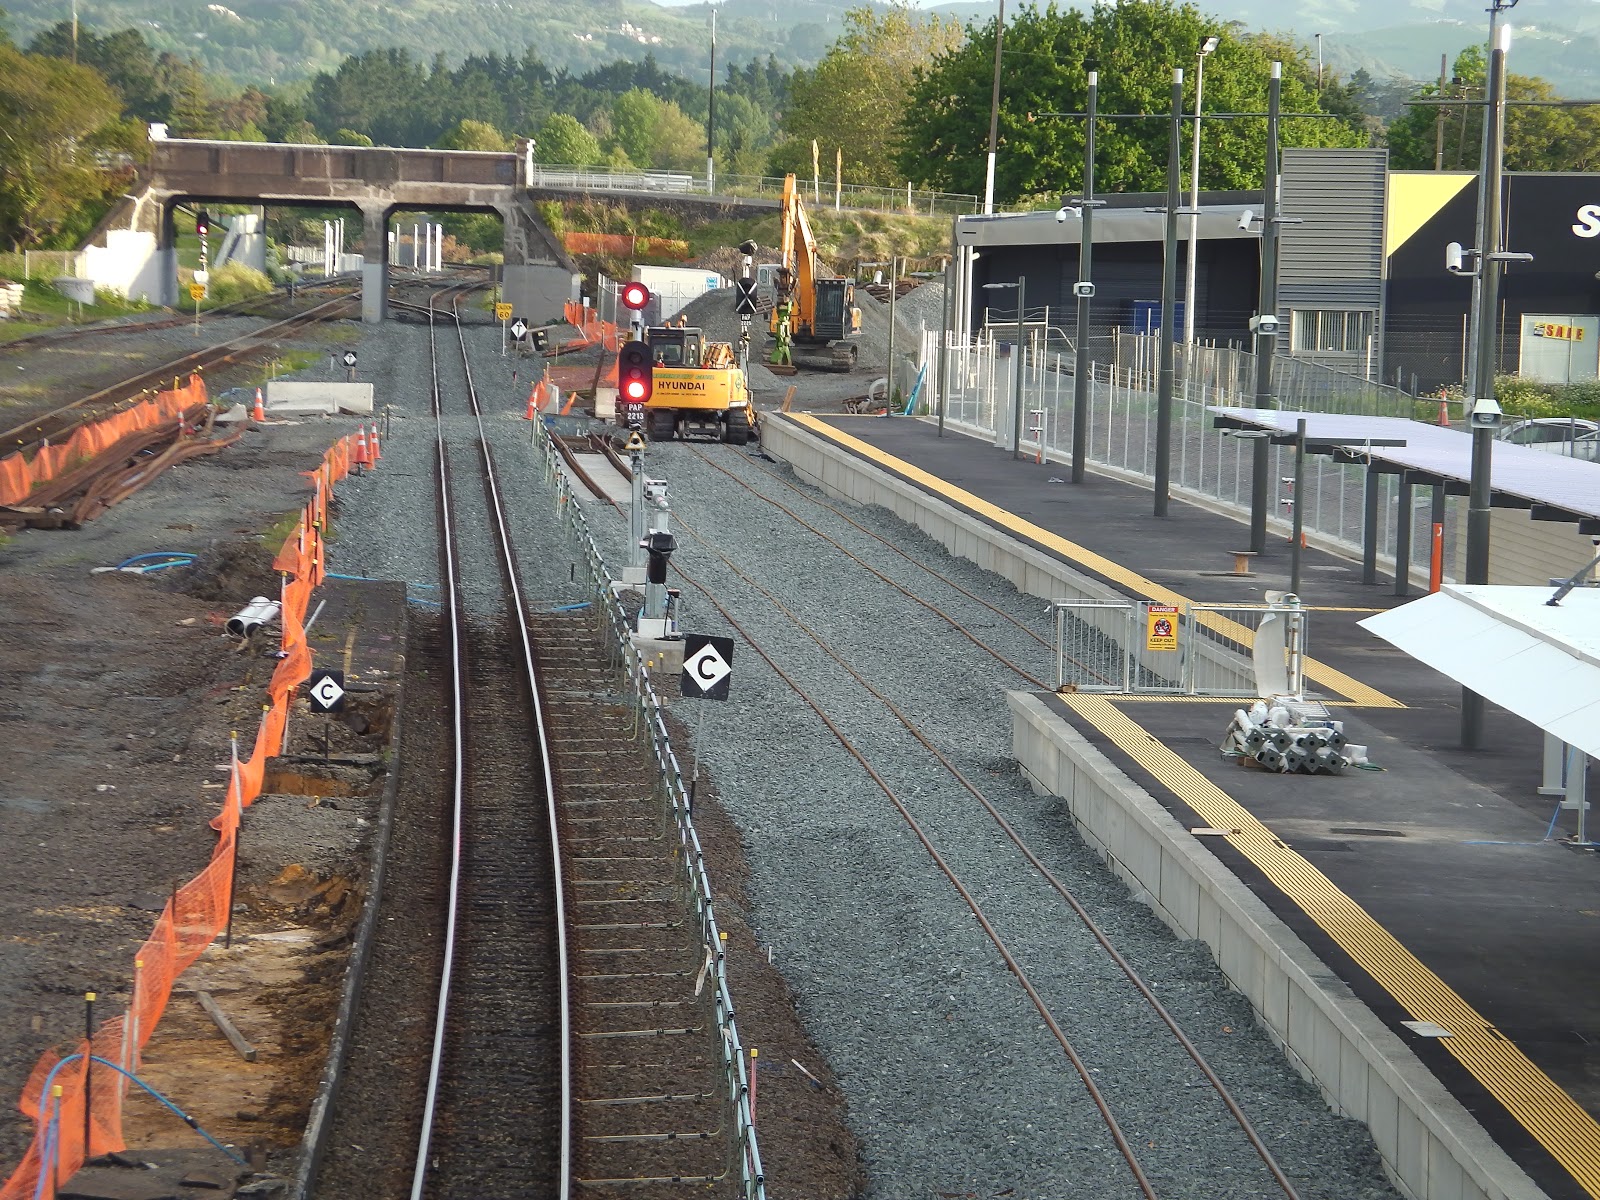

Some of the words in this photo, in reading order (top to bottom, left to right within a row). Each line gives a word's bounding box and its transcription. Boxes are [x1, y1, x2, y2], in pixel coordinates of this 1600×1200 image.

[1546, 324, 1583, 341] SALE
[658, 381, 705, 391] HYUNDAI
[628, 404, 643, 412] PAP
[697, 655, 718, 680] C
[321, 683, 334, 700] C
